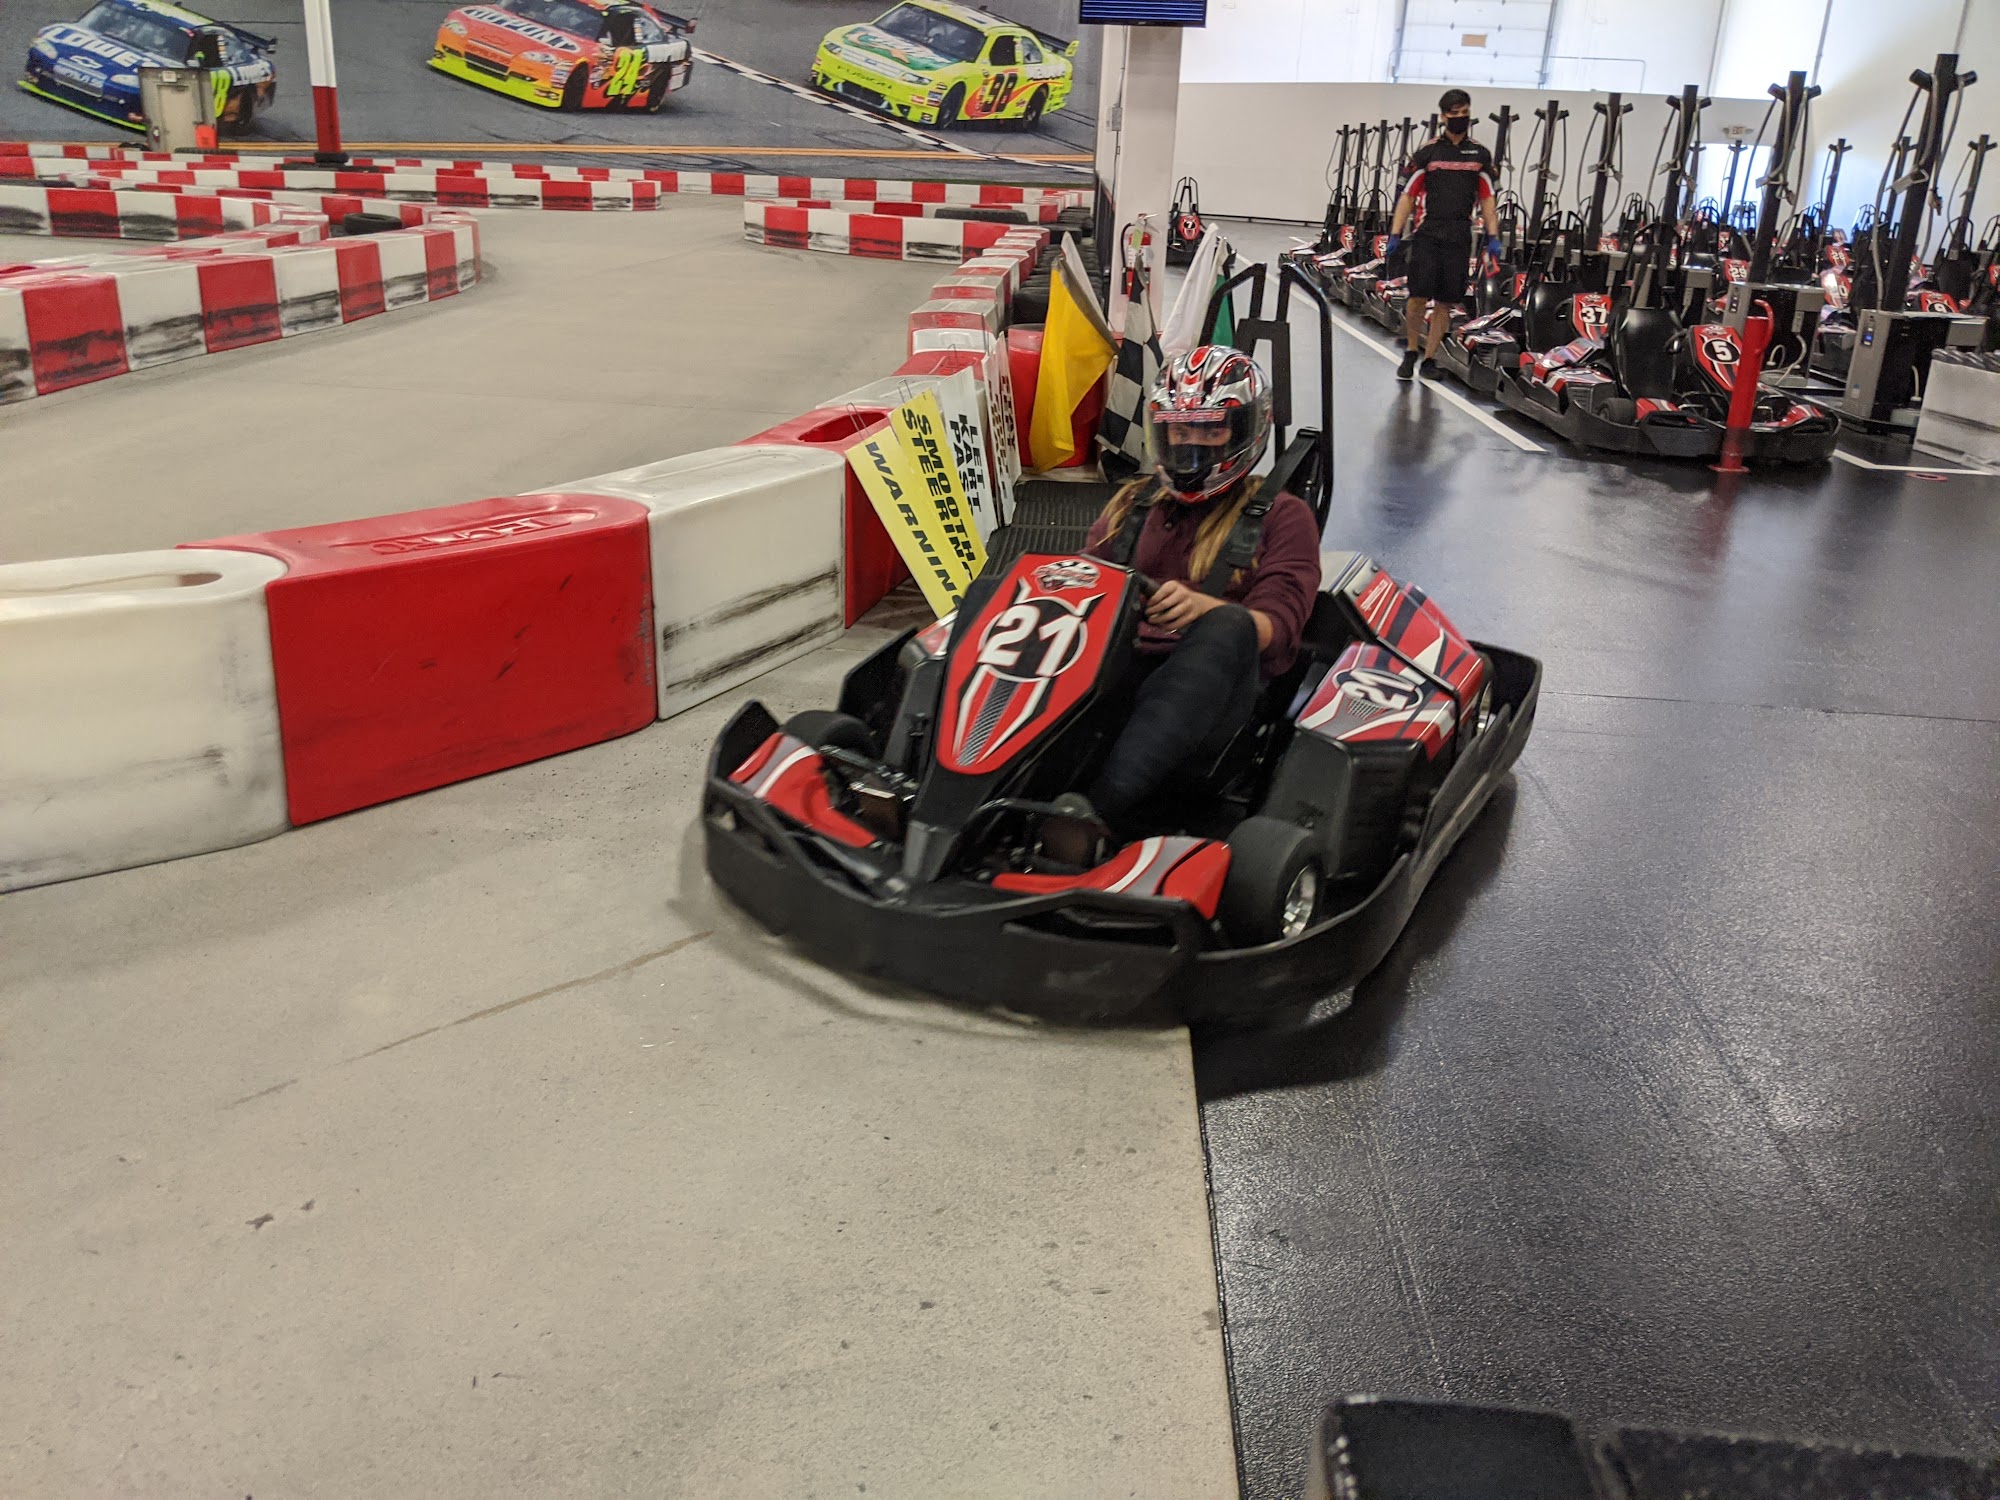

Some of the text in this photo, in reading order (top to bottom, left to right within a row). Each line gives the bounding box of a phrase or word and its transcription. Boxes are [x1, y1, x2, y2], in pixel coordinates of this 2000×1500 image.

[607, 47, 645, 96] 24
[1185, 221, 1193, 229] 7
[1731, 266, 1748, 279] 29
[1581, 307, 1608, 325] 37
[1934, 302, 1946, 313] 9
[1715, 344, 1733, 361] 5
[958, 413, 982, 512] KART
[969, 425, 986, 490] LET
[917, 414, 976, 562] SMOOTH
[977, 604, 1083, 678] 21
[1341, 668, 1418, 711] 21
